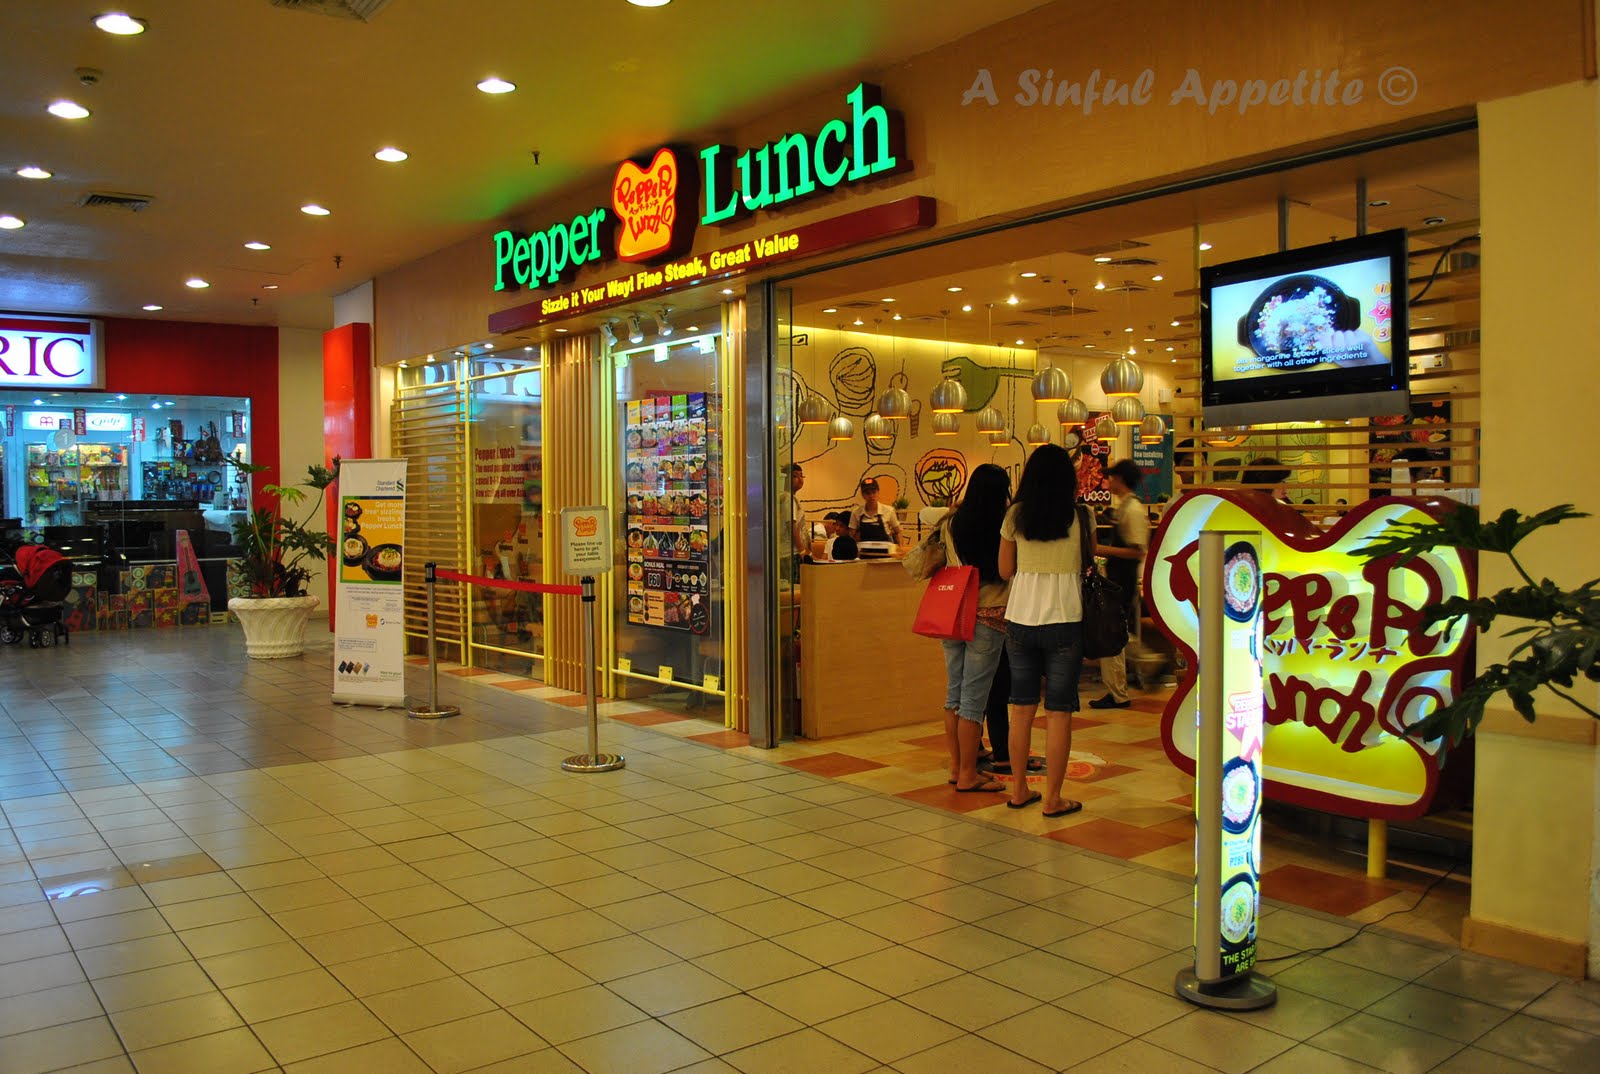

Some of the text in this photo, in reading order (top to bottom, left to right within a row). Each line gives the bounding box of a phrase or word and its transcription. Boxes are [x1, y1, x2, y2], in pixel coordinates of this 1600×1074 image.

[493, 82, 897, 293] Pepper Lunch
[541, 233, 800, 315] Sizzle it Your Way! Fine Steak, Great Value
[1378, 305, 1388, 316] 2
[1379, 328, 1388, 338] 3
[1233, 351, 1368, 373] together with all other ingredients
[1249, 352, 1291, 364] margarine
[1300, 348, 1320, 358] beef
[1321, 346, 1345, 356] slices
[1346, 343, 1364, 352] well
[75, 410, 85, 435] SALE
[361, 522, 383, 530] Pepper
[1222, 952, 1240, 966] THE
[1235, 959, 1249, 974] ARE
